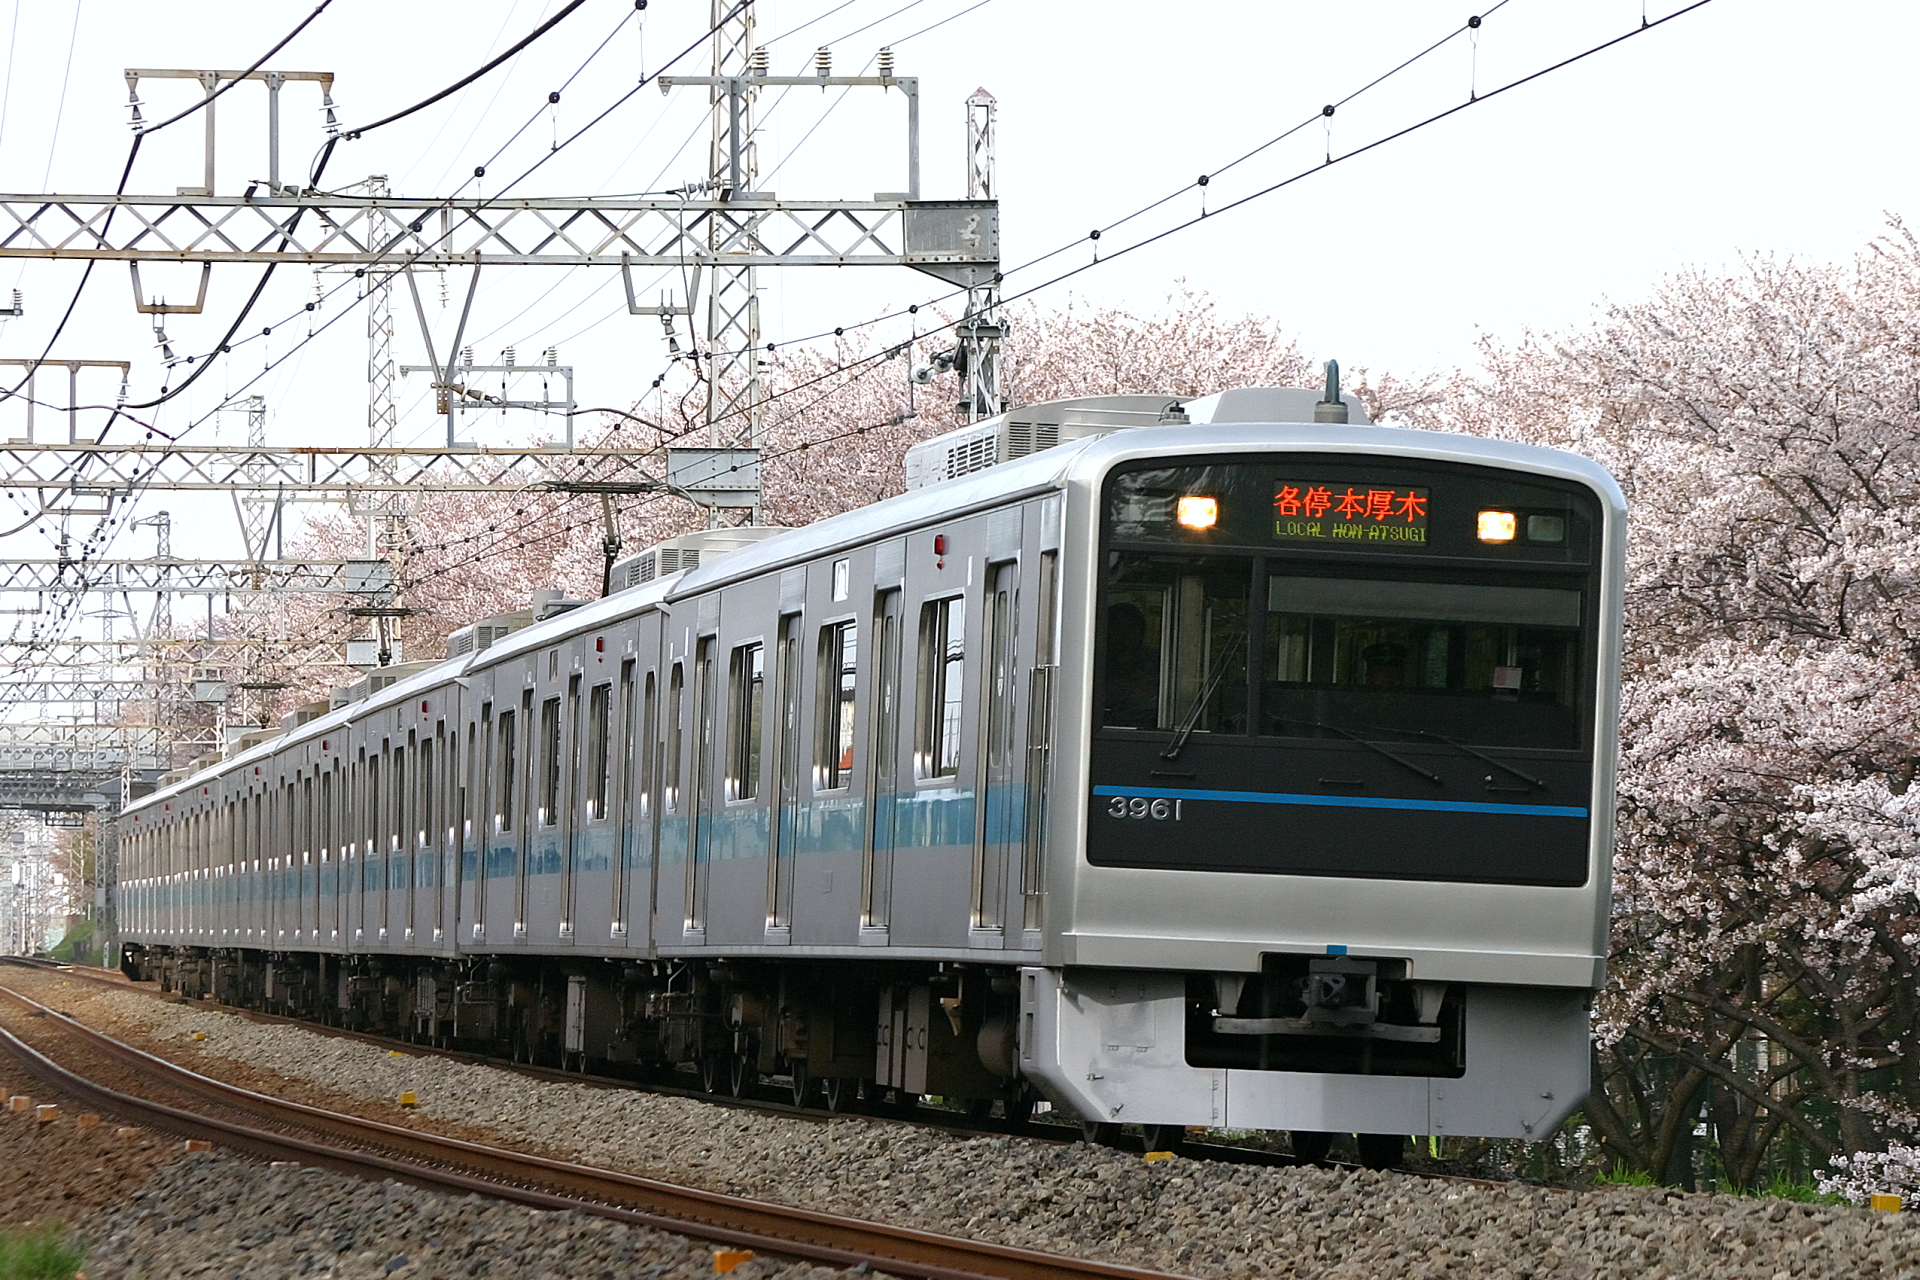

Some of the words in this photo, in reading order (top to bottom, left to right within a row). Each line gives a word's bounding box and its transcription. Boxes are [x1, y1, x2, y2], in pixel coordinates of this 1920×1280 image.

[1275, 520, 1326, 538] LOCAL
[1332, 522, 1426, 542] HON-ATSUGI
[1108, 796, 1182, 821] 3961
